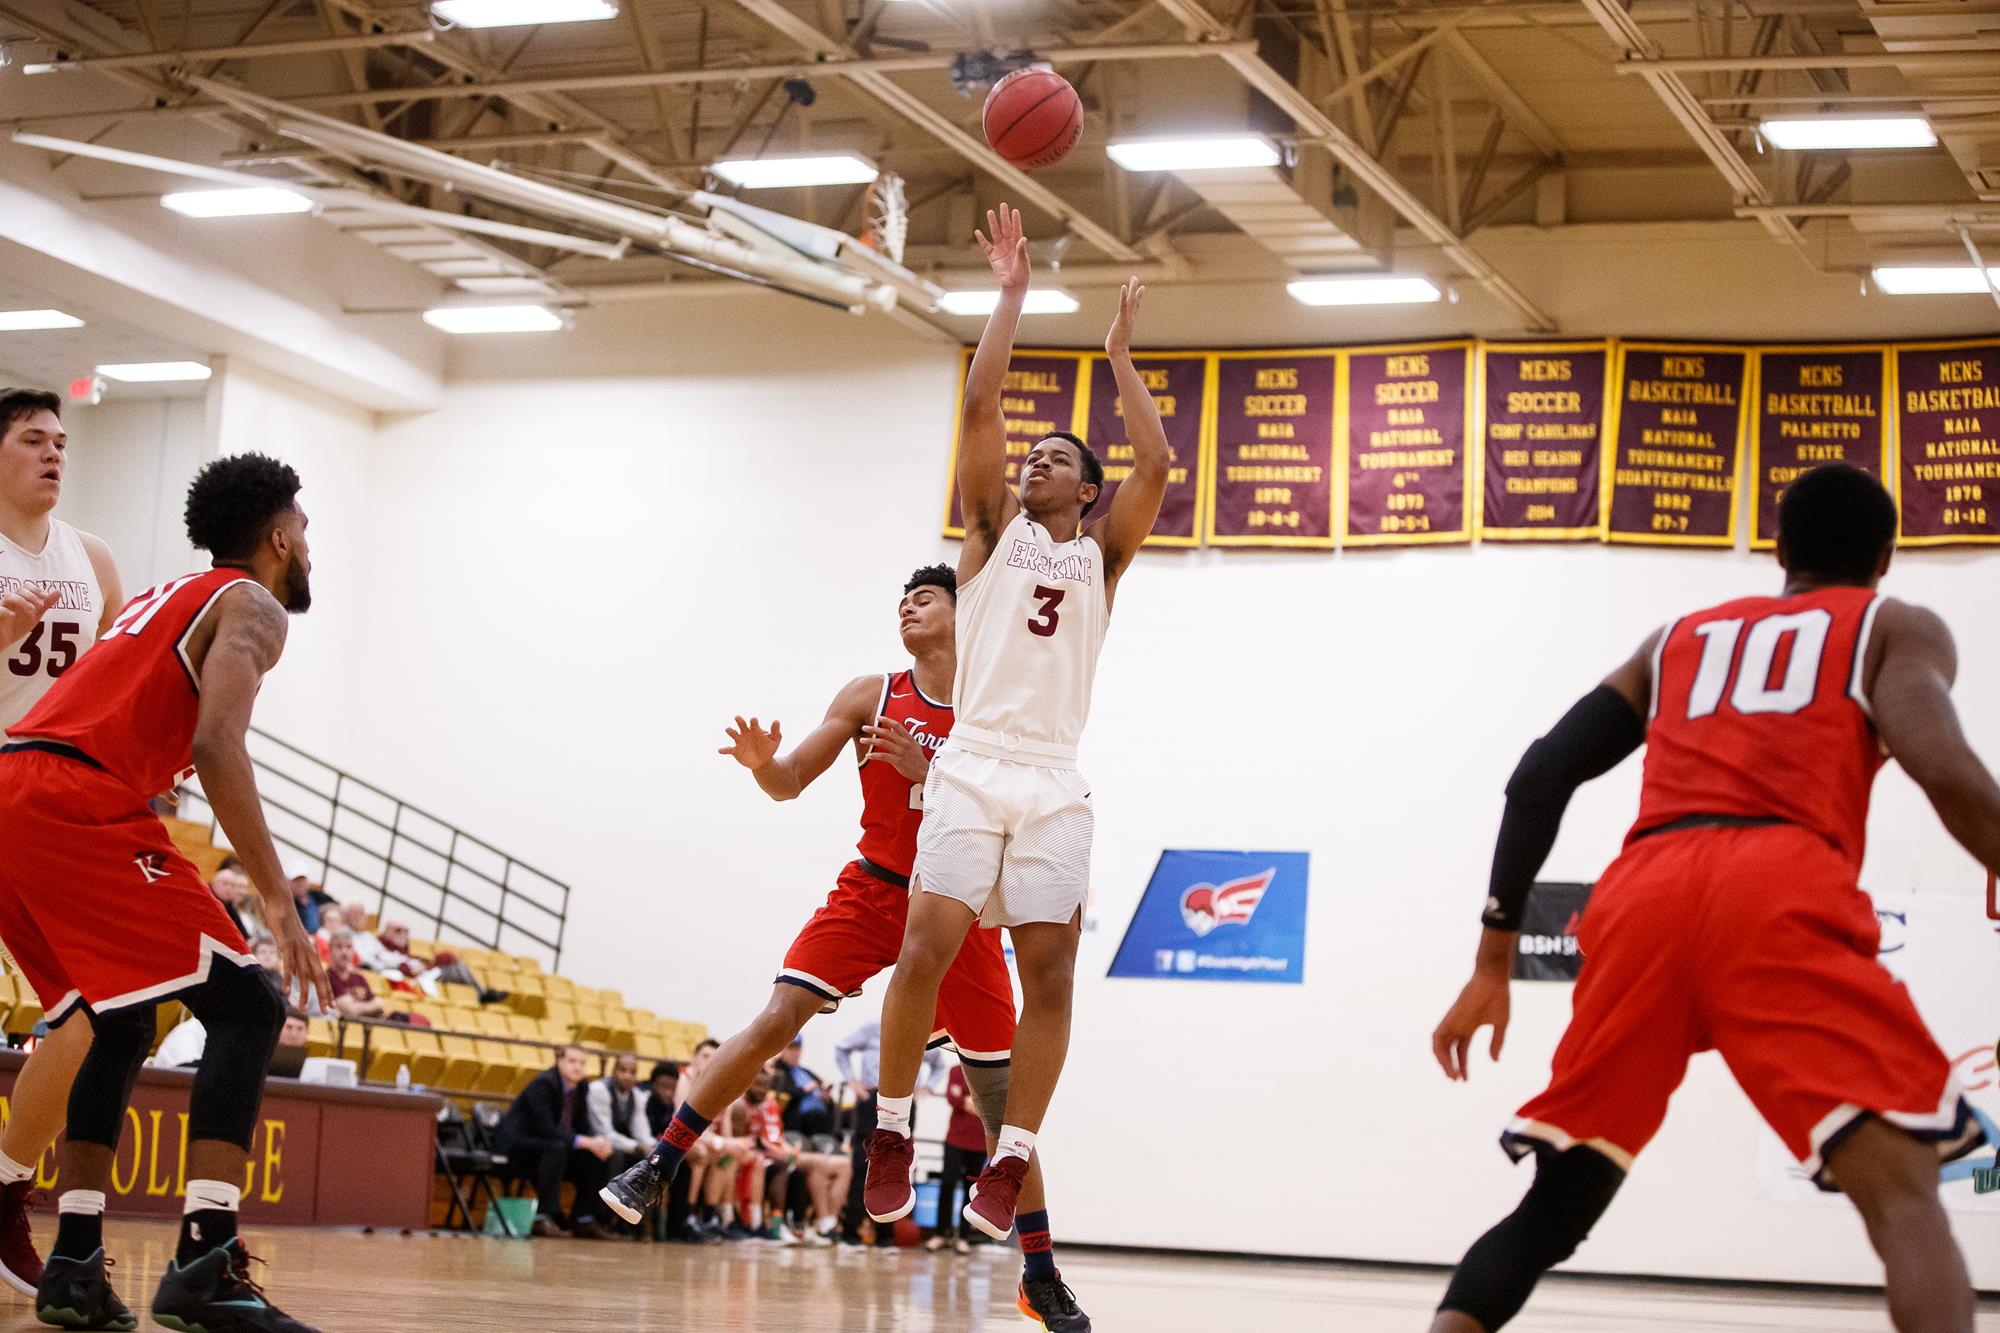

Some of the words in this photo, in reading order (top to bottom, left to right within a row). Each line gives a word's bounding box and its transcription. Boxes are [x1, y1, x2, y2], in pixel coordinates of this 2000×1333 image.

[1385, 355, 1430, 378] MENS
[1520, 359, 1572, 382] MENS
[1662, 356, 1705, 378] MENS
[1800, 365, 1843, 387] MENS
[1939, 360, 1983, 384] MENS
[1256, 368, 1298, 389] MENS
[1375, 380, 1439, 405] SOCCER
[1507, 391, 1581, 414] SOCCER
[1628, 379, 1736, 406] BASKETBALL
[1244, 394, 1307, 416] SOCCER
[1767, 393, 1876, 417] BASKETBALL
[1661, 408, 1697, 426] NAIA
[1944, 417, 1981, 435] NAIA
[1370, 428, 1443, 448] NATIONAL
[1526, 422, 1597, 440] CAROLINAS
[1642, 428, 1716, 449] NATIONAL
[1780, 421, 1861, 439] PALMETTO
[1238, 444, 1309, 461] NATIONAL
[1359, 449, 1455, 470] TOURNAMENT
[1532, 450, 1583, 467] SEASON
[1627, 448, 1725, 471] TOURNAMENT
[1797, 444, 1845, 461] STATE
[1926, 438, 2000, 459] NATIONAL
[1226, 465, 1322, 482] TOURNAMENT
[1615, 469, 1734, 492] QUARTERFINALS
[1505, 477, 1578, 494] CHAMPIONS
[1027, 584, 1066, 638] 3
[8, 621, 79, 678] 35
[1686, 608, 1832, 720] 10
